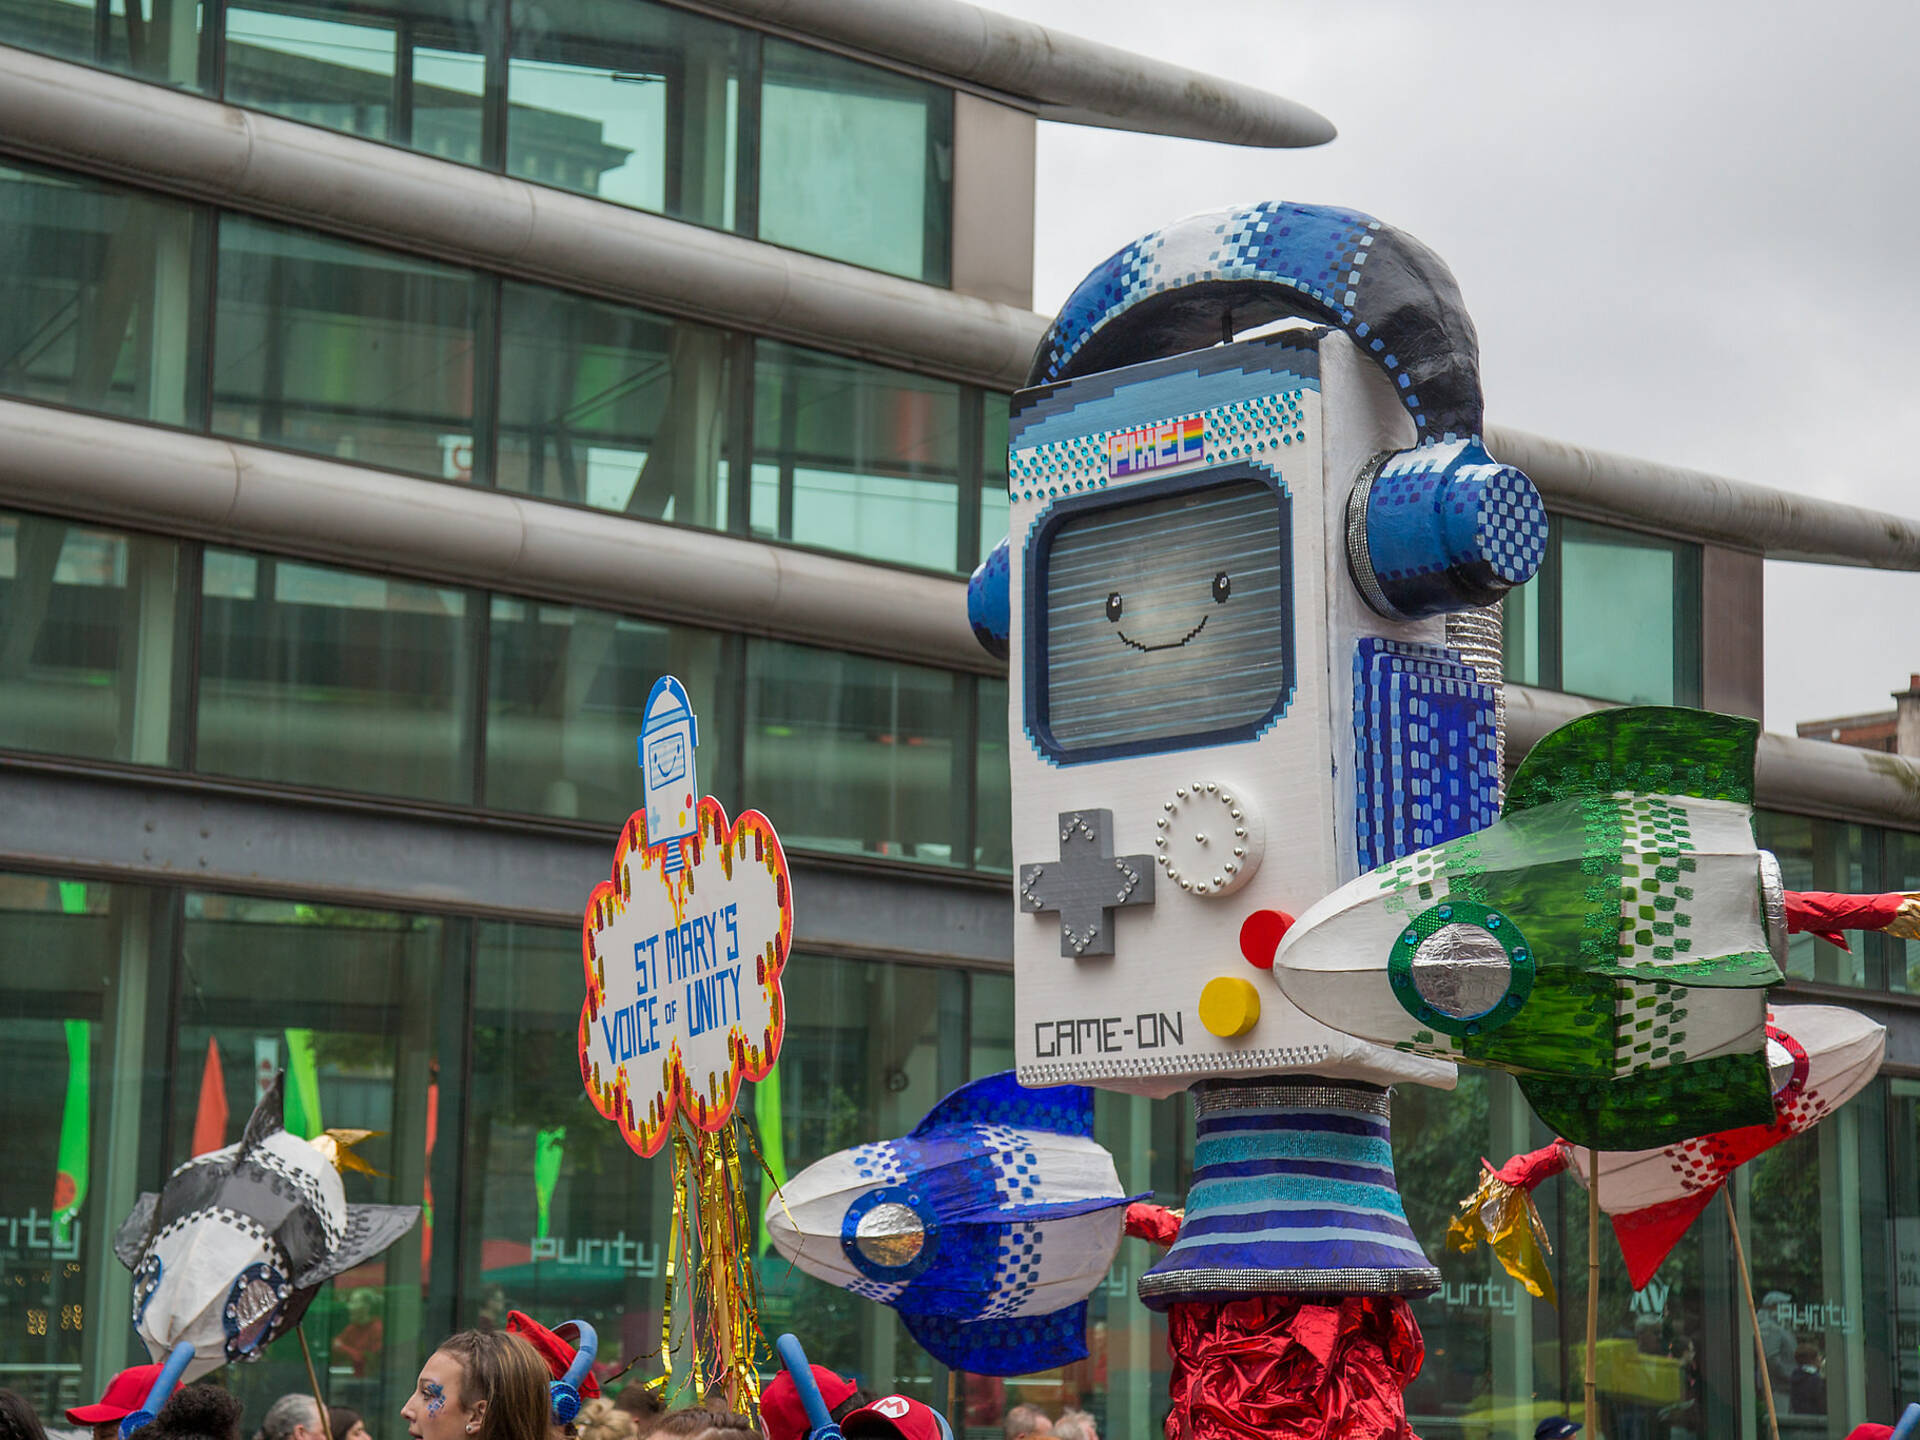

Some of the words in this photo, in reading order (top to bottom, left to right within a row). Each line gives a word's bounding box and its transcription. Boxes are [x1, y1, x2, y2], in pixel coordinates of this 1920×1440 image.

[1109, 423, 1202, 475] PIXEL
[633, 934, 660, 996] ST
[665, 902, 740, 985] MARY'S
[601, 995, 661, 1065] VOICE
[664, 1000, 678, 1025] OF
[686, 964, 741, 1038] UNITY
[1034, 1011, 1184, 1058] GAME-ON
